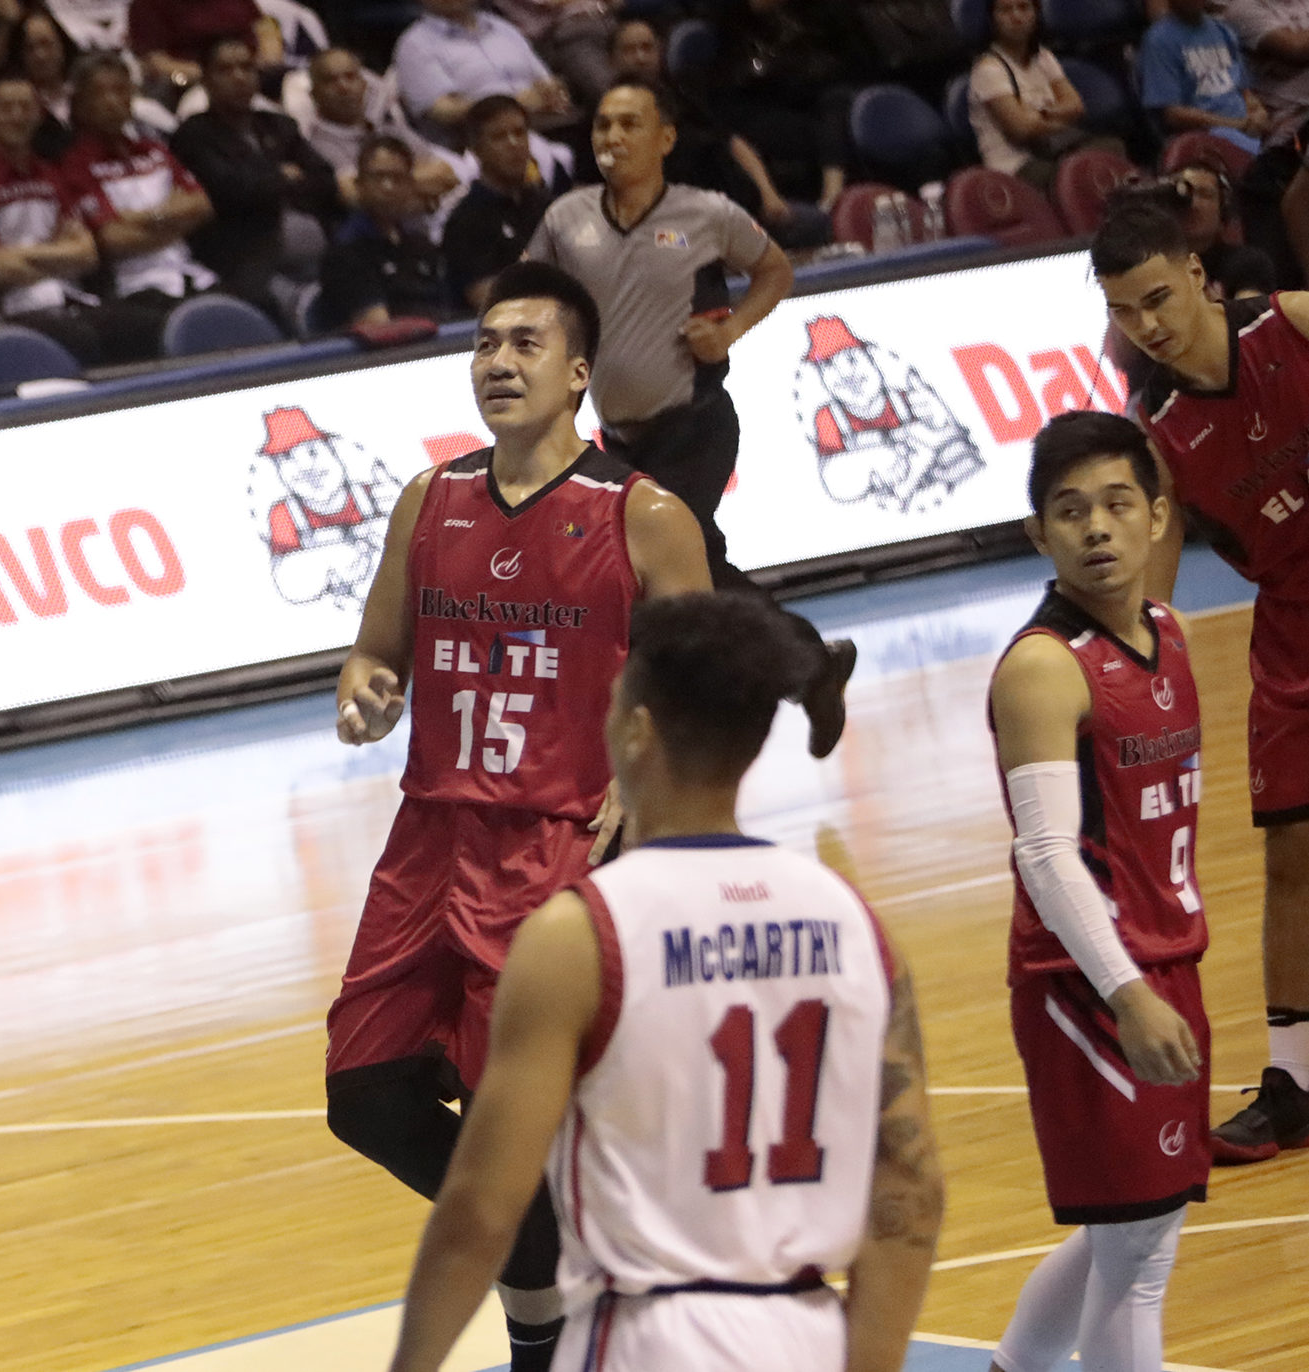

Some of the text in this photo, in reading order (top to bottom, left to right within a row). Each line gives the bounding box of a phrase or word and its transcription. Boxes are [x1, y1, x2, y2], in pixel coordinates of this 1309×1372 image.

[949, 341, 1130, 444] Dav
[418, 586, 590, 628] Blackwater
[452, 689, 534, 774] 15
[1169, 826, 1201, 914] 9
[663, 919, 842, 988] McCARTHY
[703, 999, 830, 1193] 11
